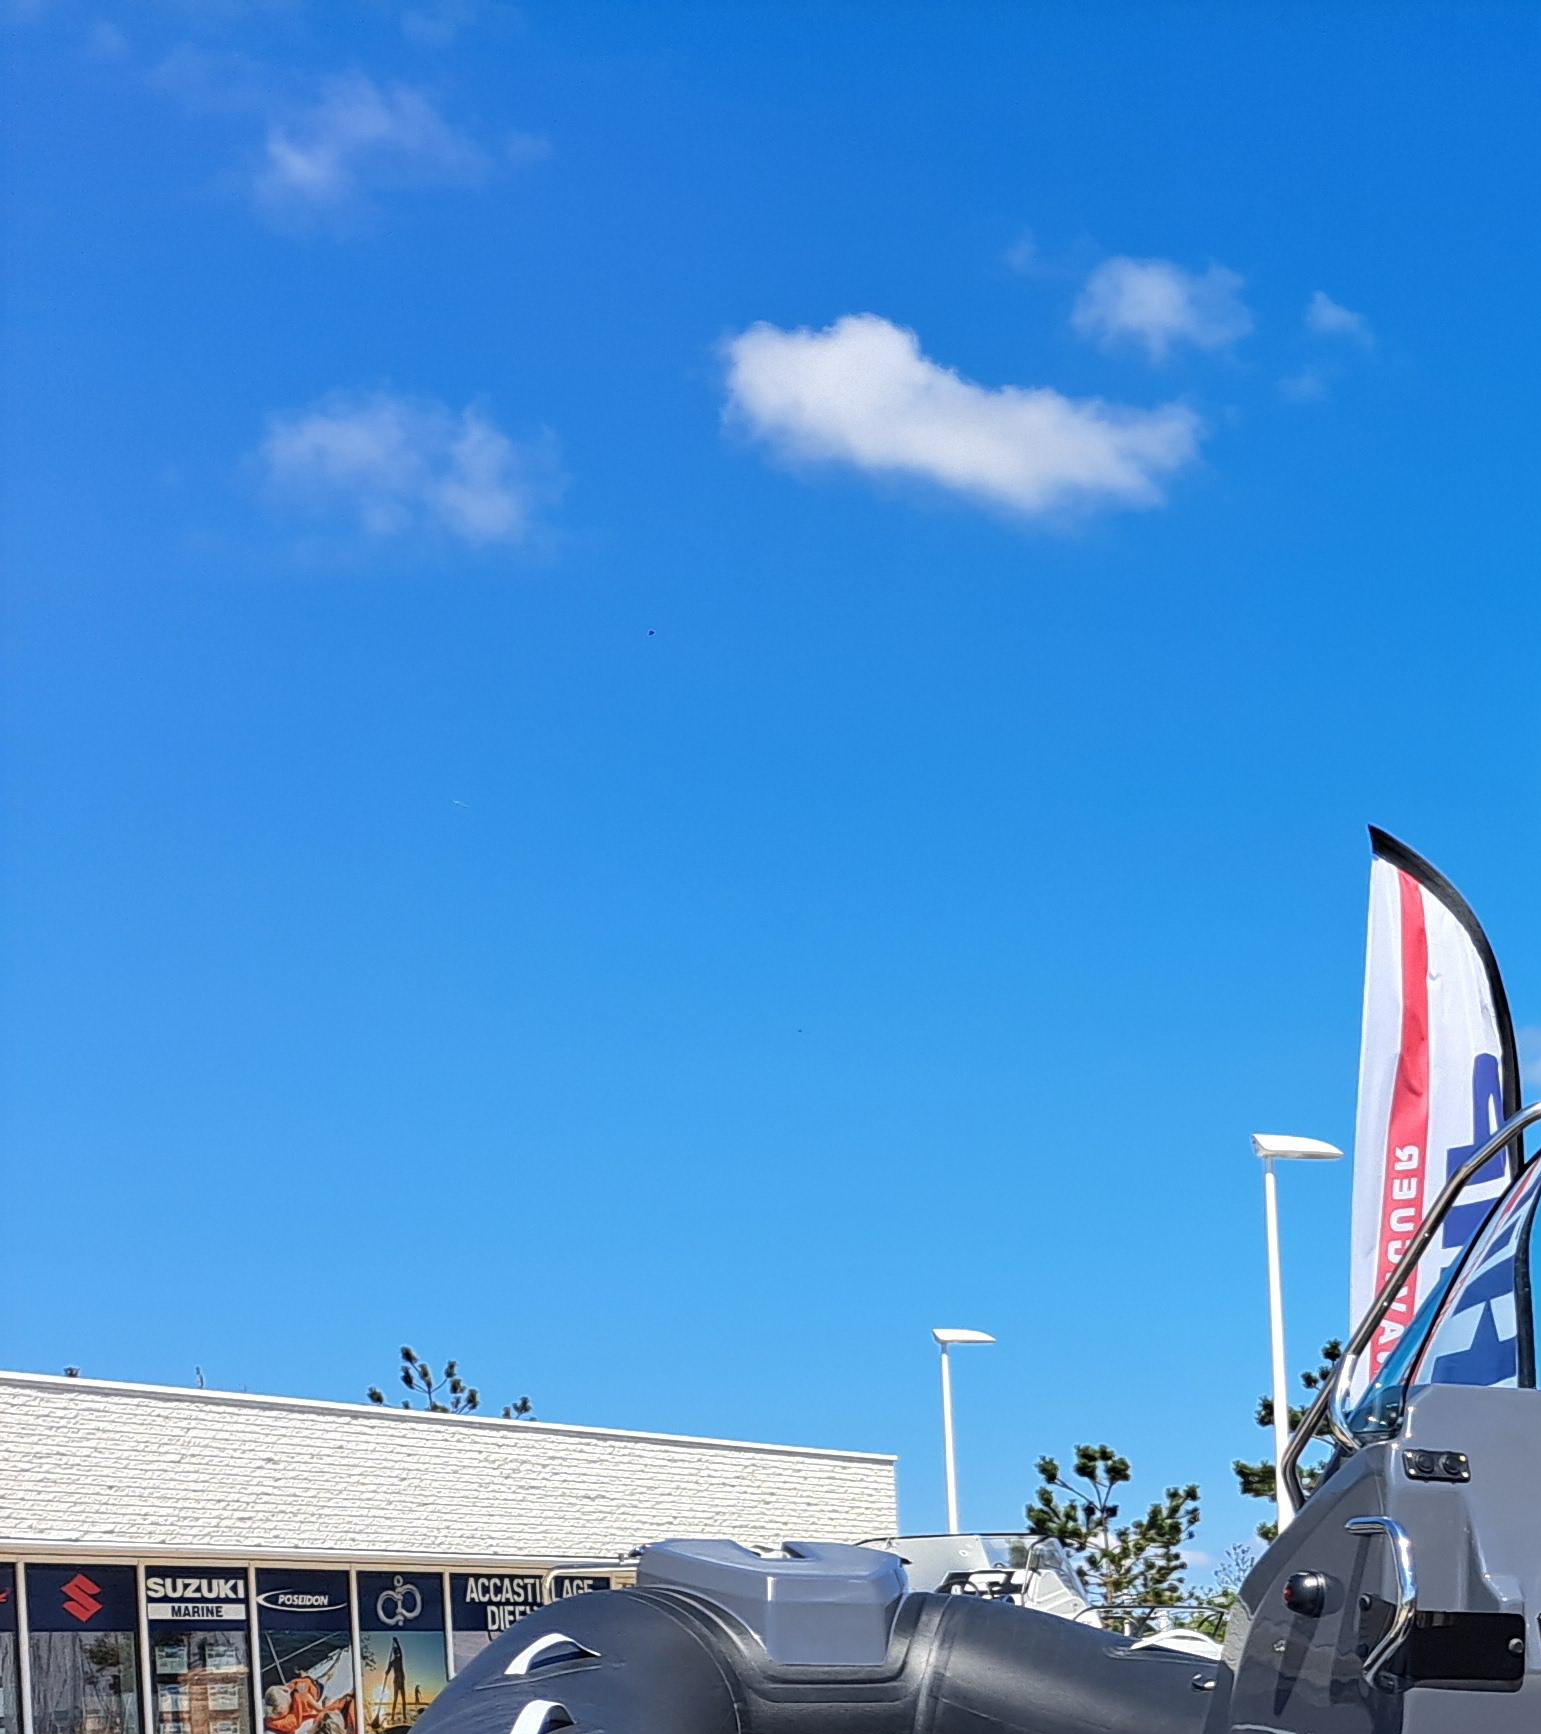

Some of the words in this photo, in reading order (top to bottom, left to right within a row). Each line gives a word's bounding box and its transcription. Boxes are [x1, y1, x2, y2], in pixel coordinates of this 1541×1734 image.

[146, 1577, 245, 1599] SUZUKI
[465, 1577, 594, 1603] ACCASTILAGE
[278, 1594, 329, 1606] POSEIDON
[171, 1605, 223, 1618] MARINE
